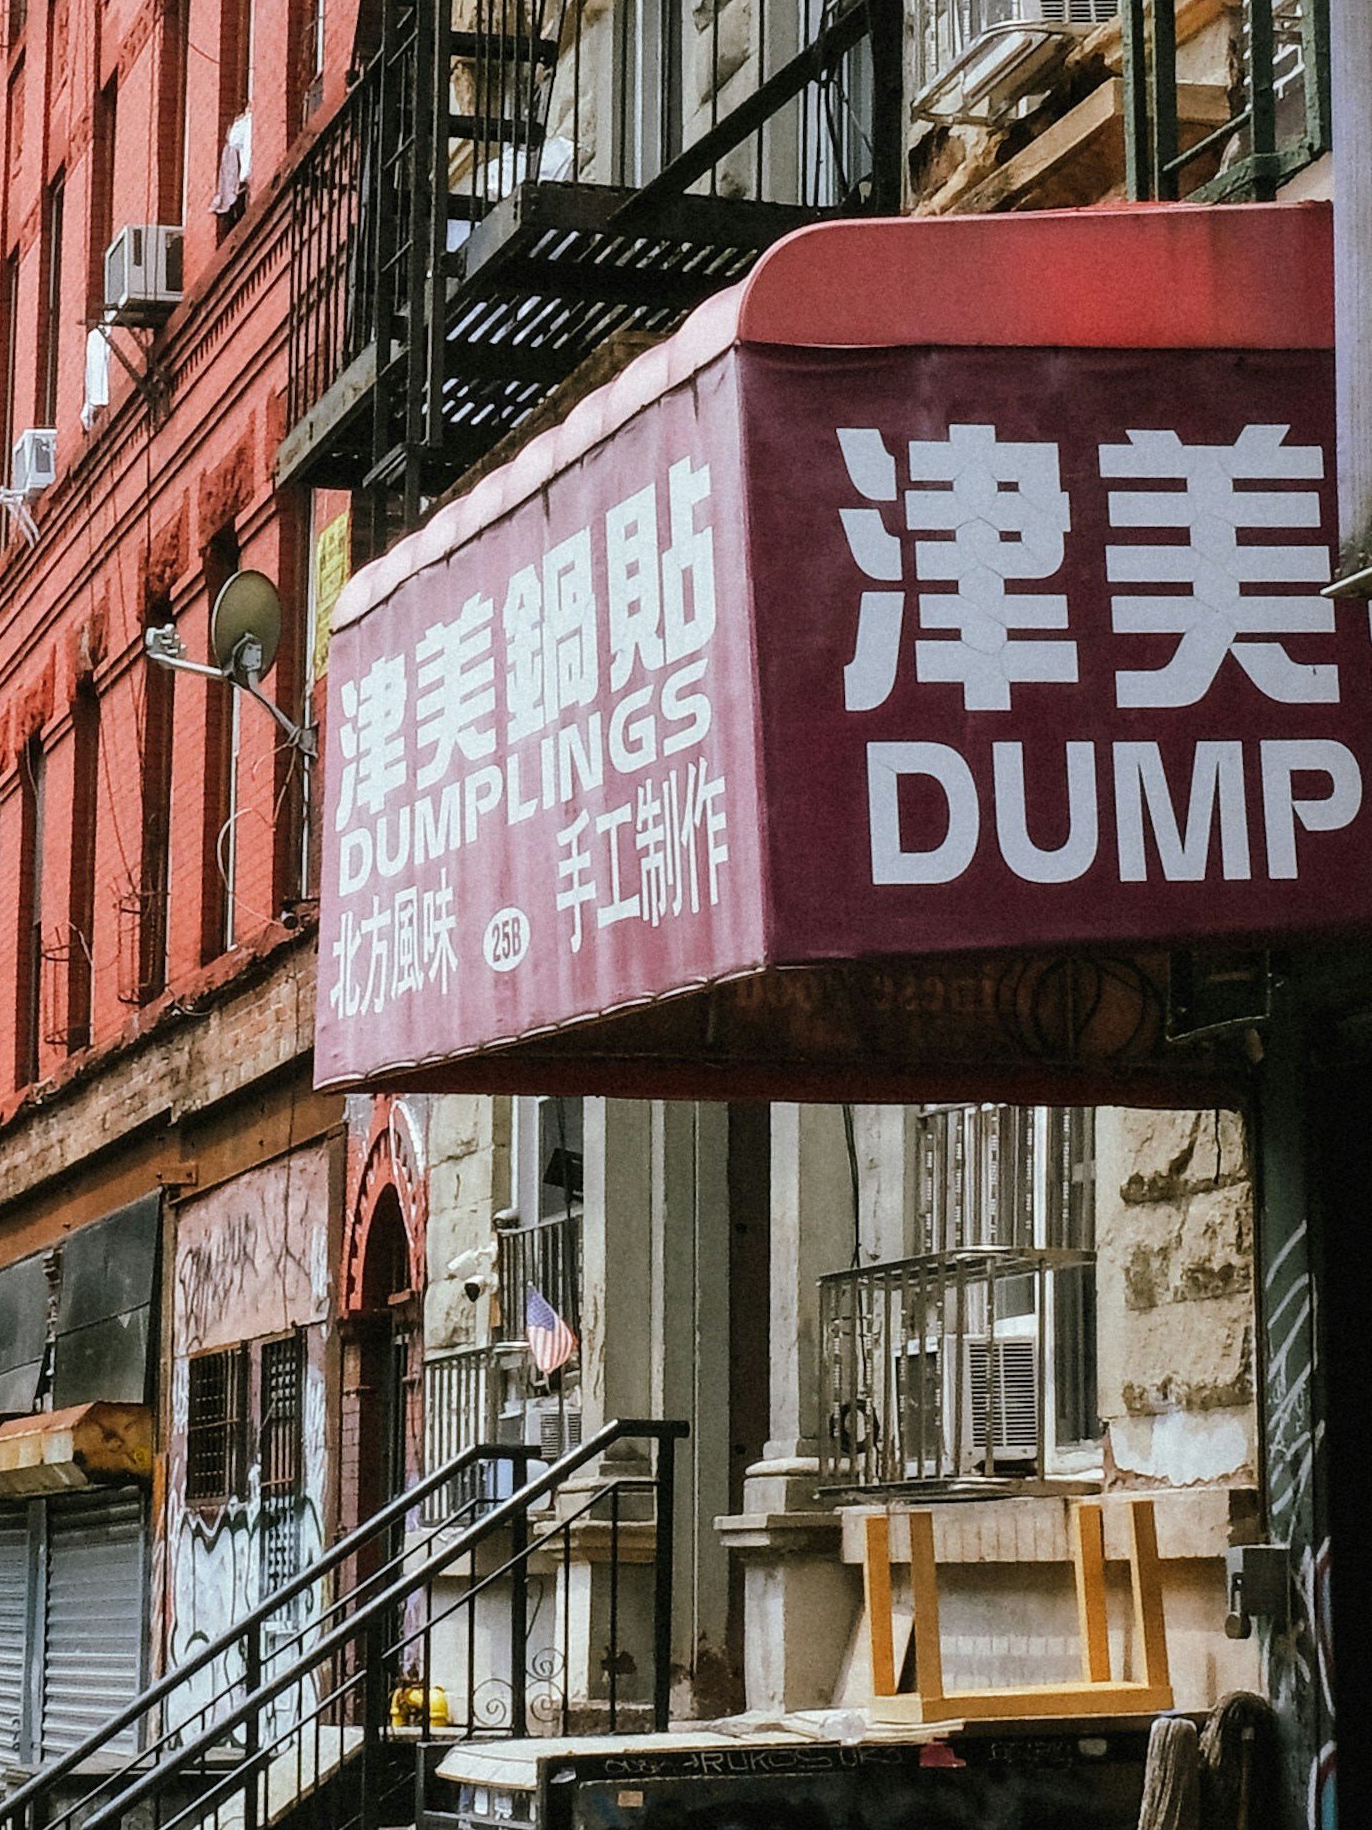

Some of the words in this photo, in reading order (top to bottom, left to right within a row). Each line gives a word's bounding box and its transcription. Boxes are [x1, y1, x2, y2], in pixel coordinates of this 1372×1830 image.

[334, 454, 717, 833] 津美鍋貼
[338, 657, 712, 898] DUMPLINGS
[555, 755, 729, 954] 手工制作
[329, 867, 459, 1020] 北方風味
[491, 915, 523, 963] 25B
